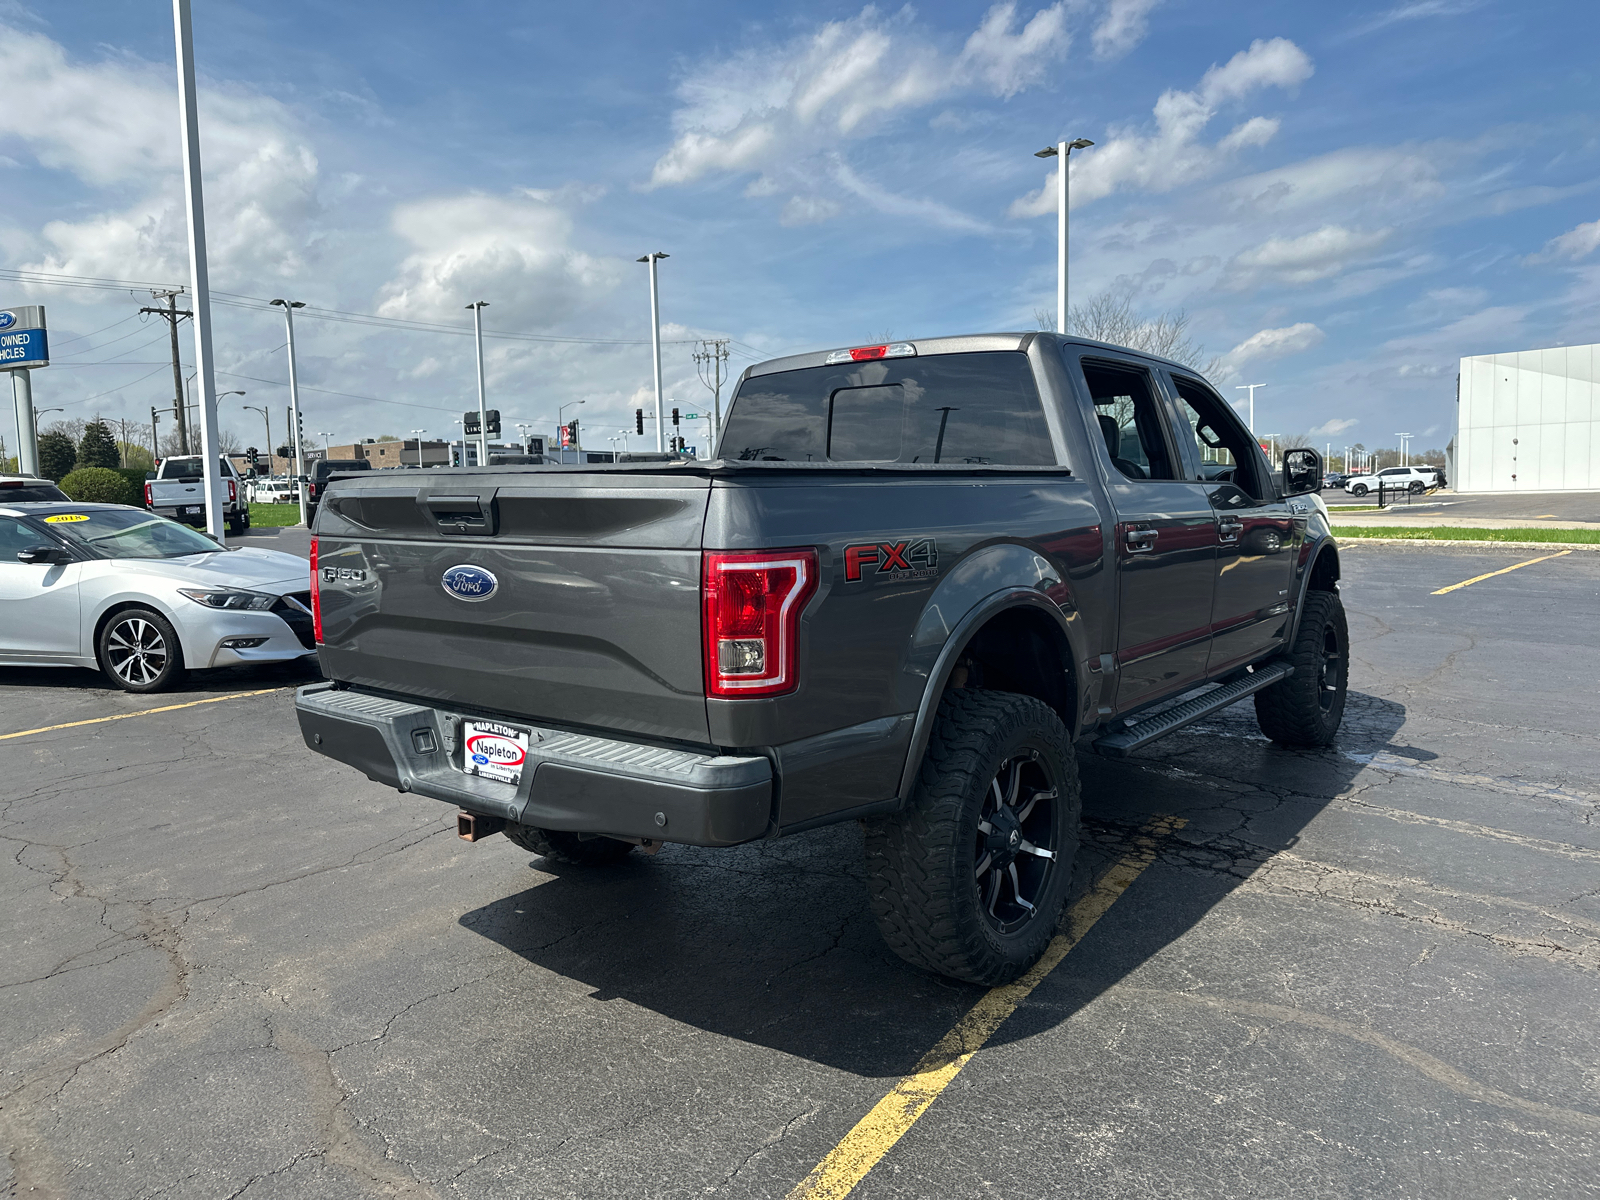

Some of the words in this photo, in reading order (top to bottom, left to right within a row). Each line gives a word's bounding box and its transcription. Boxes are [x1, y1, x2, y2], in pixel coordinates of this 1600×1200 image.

[1, 334, 30, 346] OWNED
[0, 347, 25, 360] HICLES
[466, 425, 493, 433] LINCLN
[842, 538, 938, 584] FX4
[889, 571, 909, 580] OFF
[912, 568, 938, 578] ROAD
[453, 572, 482, 592] Ford
[475, 722, 514, 737] NAPLETON
[476, 740, 517, 760] Napleton
[474, 755, 486, 764] Ford
[478, 771, 512, 784] LIBERTYVILLE
